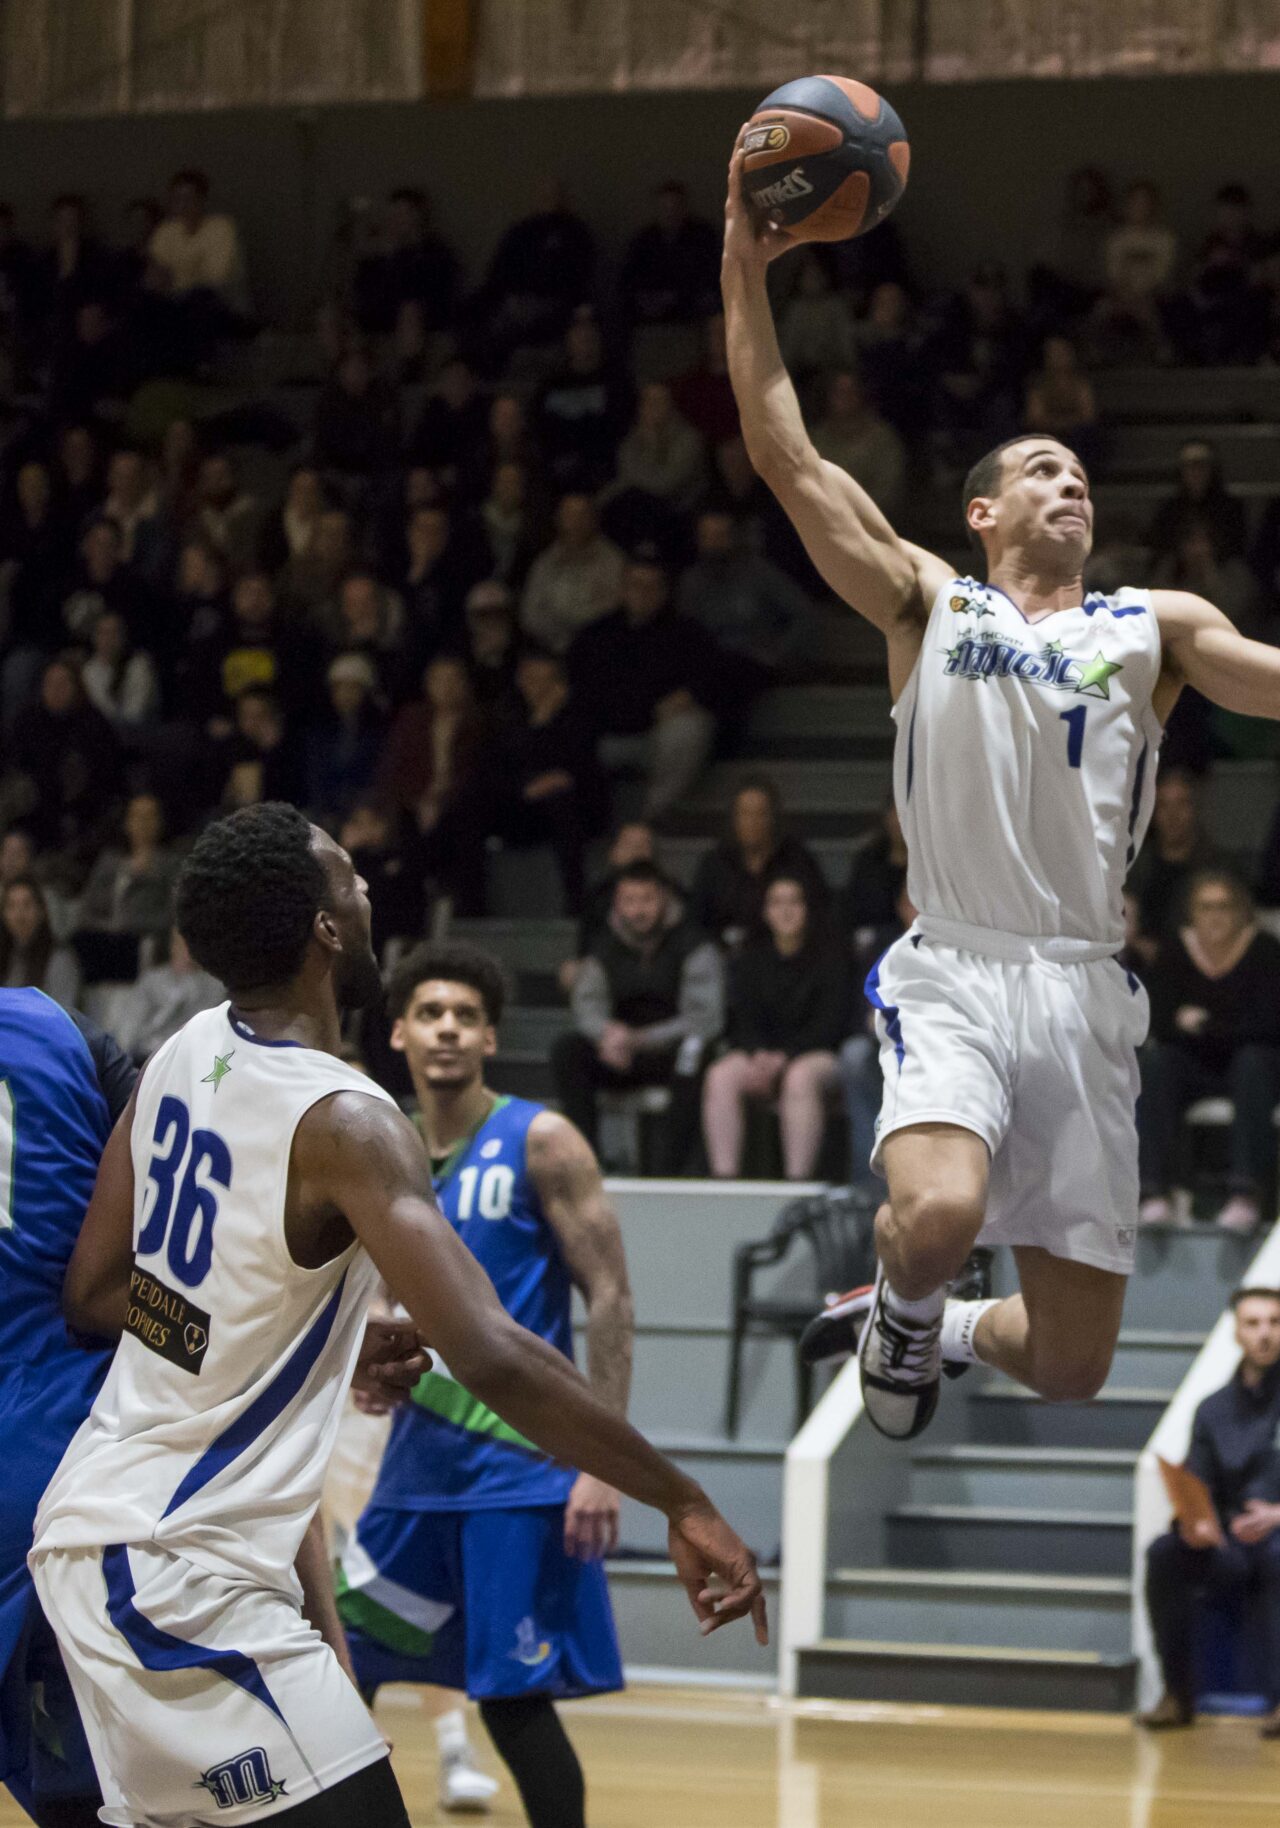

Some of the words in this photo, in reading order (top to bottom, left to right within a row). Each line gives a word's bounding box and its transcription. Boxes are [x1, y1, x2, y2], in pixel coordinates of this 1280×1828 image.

[943, 637, 1086, 690] MAGIC
[1059, 704, 1088, 769] 1
[137, 1094, 233, 1290] 36
[457, 1164, 516, 1221] 10
